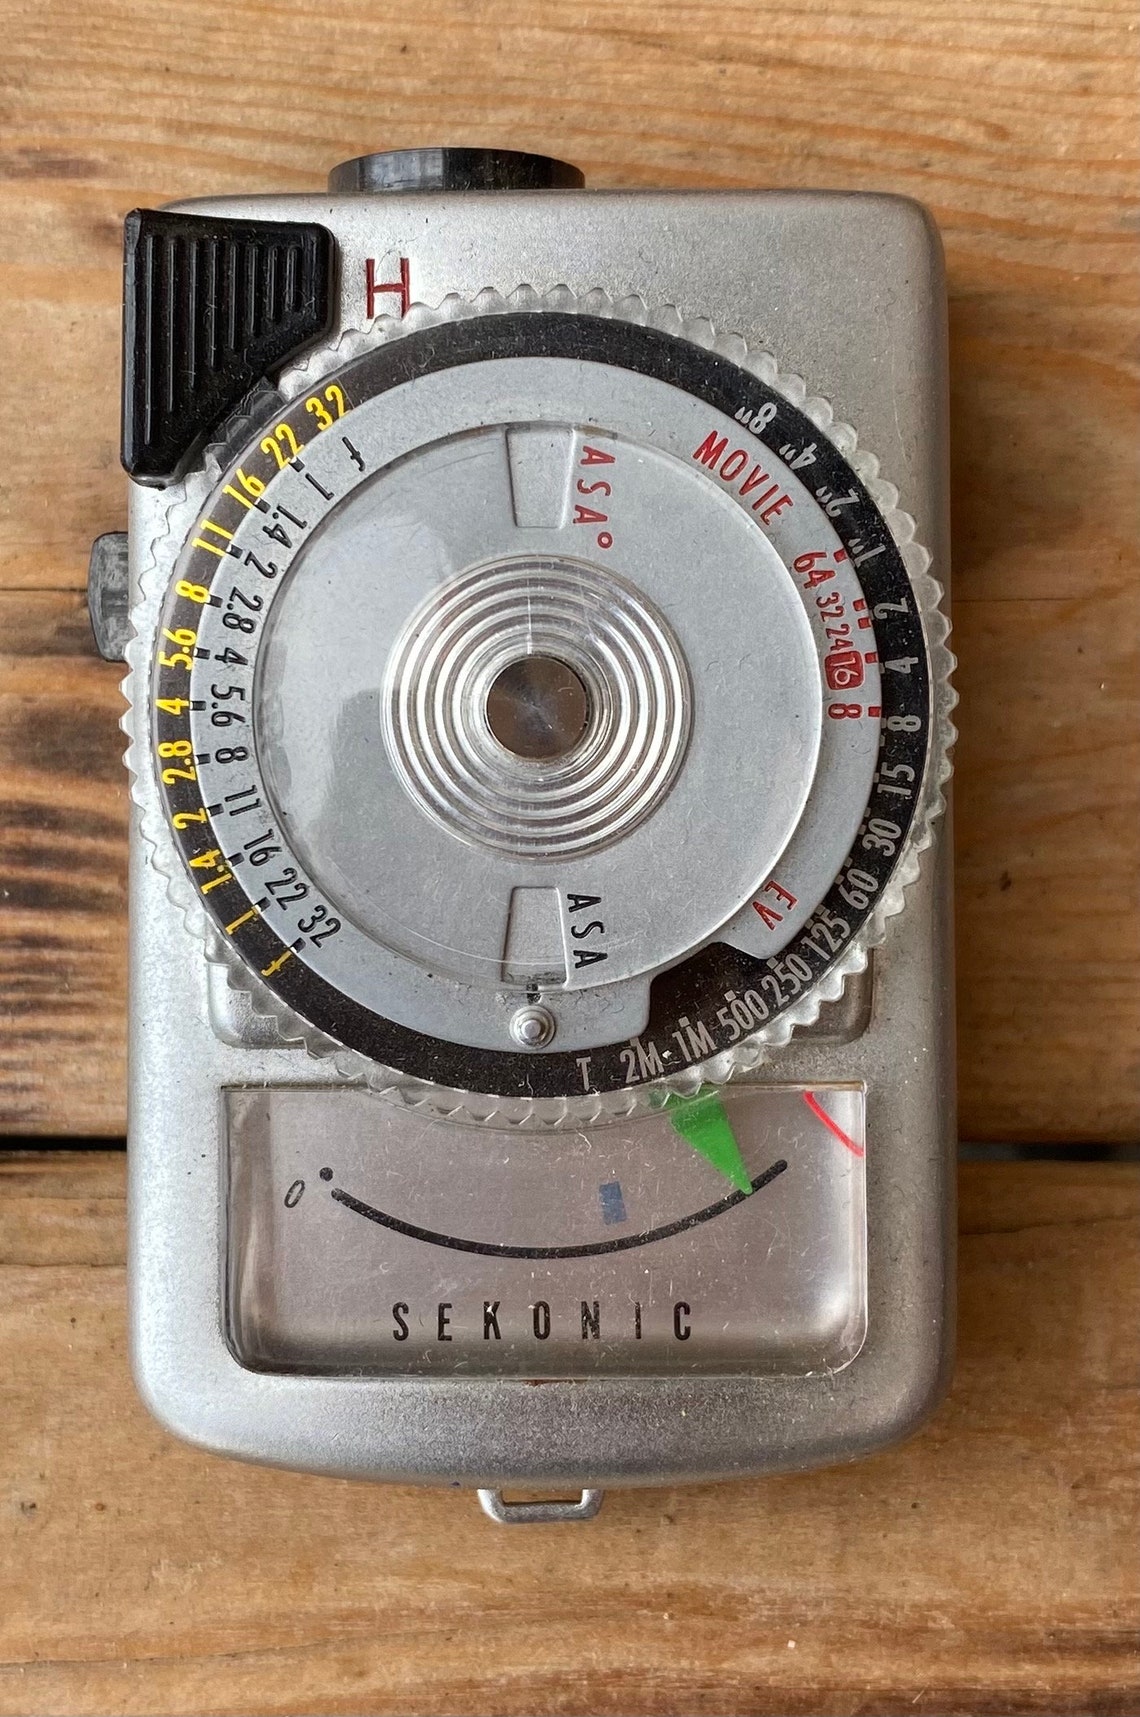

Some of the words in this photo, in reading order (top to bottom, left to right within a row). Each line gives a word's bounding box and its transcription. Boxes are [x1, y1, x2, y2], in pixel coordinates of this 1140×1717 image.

[365, 257, 411, 320] H
[306, 384, 349, 431] 32
[260, 423, 305, 470] 22
[342, 436, 366, 472] f
[222, 468, 266, 510] 16
[305, 473, 335, 500] 1
[692, 430, 794, 526] MOVIE
[191, 519, 235, 557] 11
[262, 505, 308, 549] 1.4
[244, 551, 278, 579] 2
[792, 551, 837, 590] 64
[175, 580, 211, 603] 8
[222, 586, 264, 634] 2.8
[816, 592, 845, 623] 32
[874, 598, 910, 620] 2
[158, 628, 197, 671] 5.6
[215, 647, 249, 666] 4
[825, 624, 854, 650] 24
[826, 655, 860, 687] 16
[884, 656, 919, 674] 4
[155, 698, 190, 716] 4
[211, 683, 246, 727] 5.6
[828, 703, 863, 720] 8
[887, 715, 921, 732] 8
[158, 740, 196, 785] 2.8
[215, 746, 249, 765] 8
[877, 762, 916, 796] 15
[172, 807, 208, 831] 2
[224, 784, 261, 817] 11
[243, 828, 283, 867] 16
[862, 818, 902, 857] 30
[189, 849, 233, 895] 1.4
[264, 867, 310, 911] 22
[839, 868, 879, 910] 60
[224, 907, 258, 935] 1
[752, 880, 798, 931] EV
[298, 904, 341, 949] 32
[567, 893, 608, 969] ASA
[801, 909, 851, 961] 125
[761, 953, 813, 1006] 250
[716, 990, 769, 1041] 500
[619, 1038, 665, 1084] 2M
[672, 1020, 717, 1063] 1M
[576, 1056, 592, 1091] T
[284, 1179, 305, 1208] 0
[392, 1300, 693, 1342] SEKONIC
